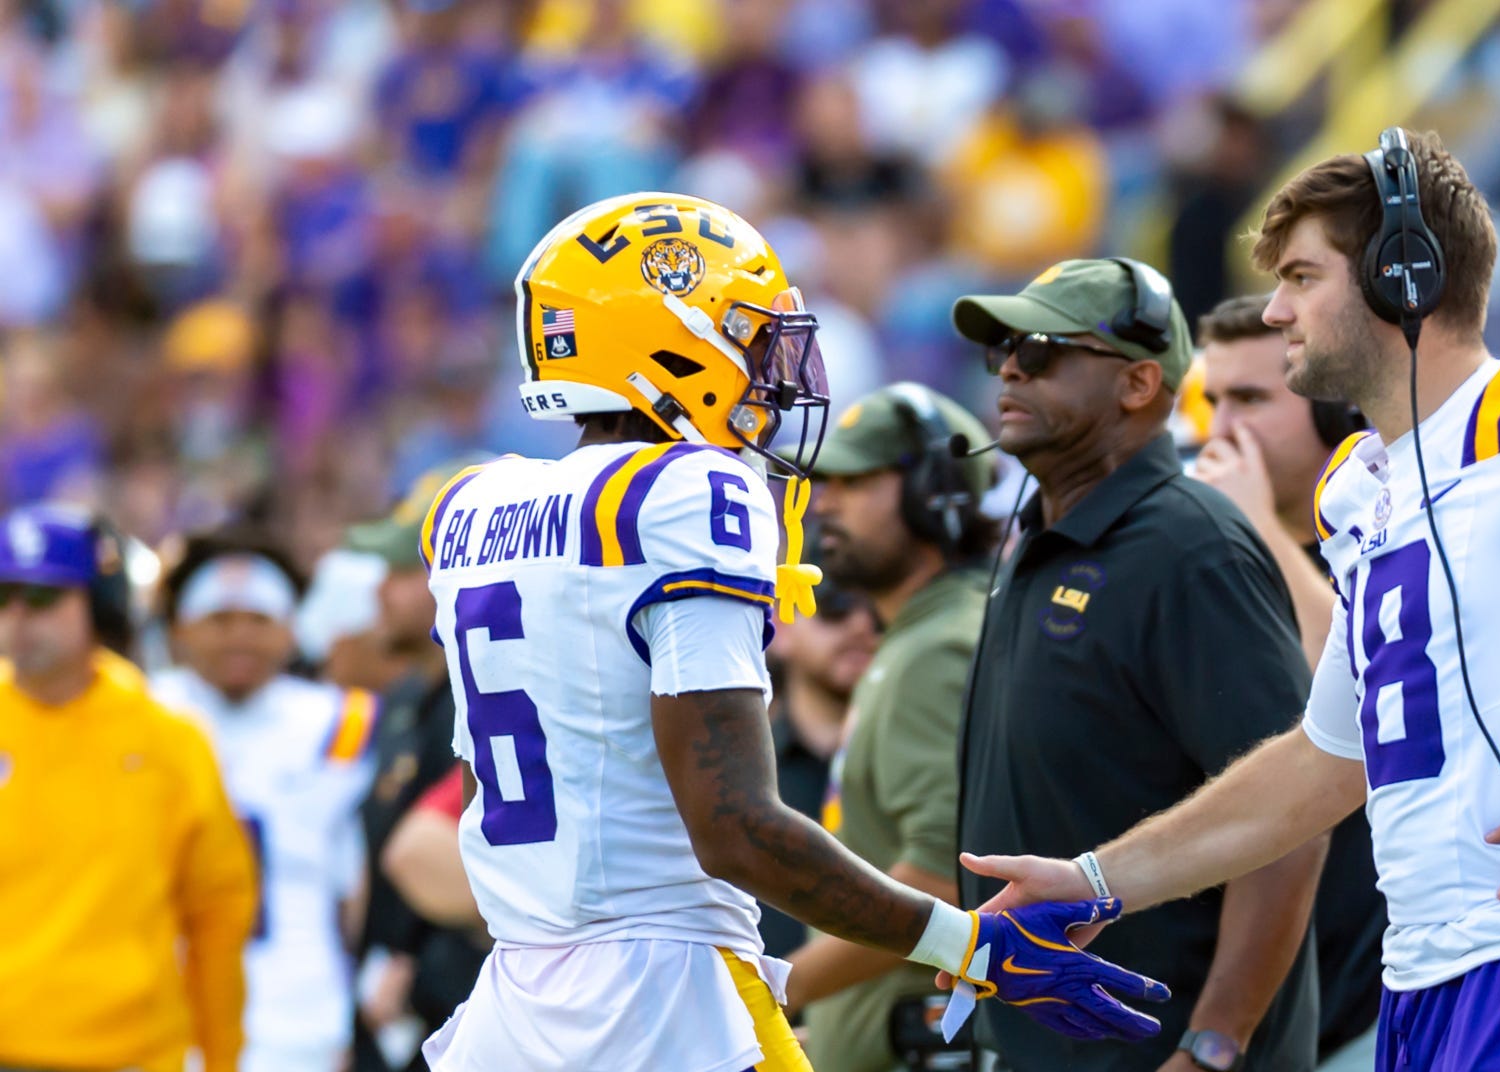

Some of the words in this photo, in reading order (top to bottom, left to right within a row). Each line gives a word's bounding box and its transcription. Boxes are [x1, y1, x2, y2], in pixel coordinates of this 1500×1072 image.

[535, 342, 544, 362] 6
[439, 507, 472, 571] BA.
[476, 493, 574, 567] BROWN
[708, 470, 752, 552] 6
[1361, 527, 1388, 556] LSU
[453, 580, 558, 847] 6
